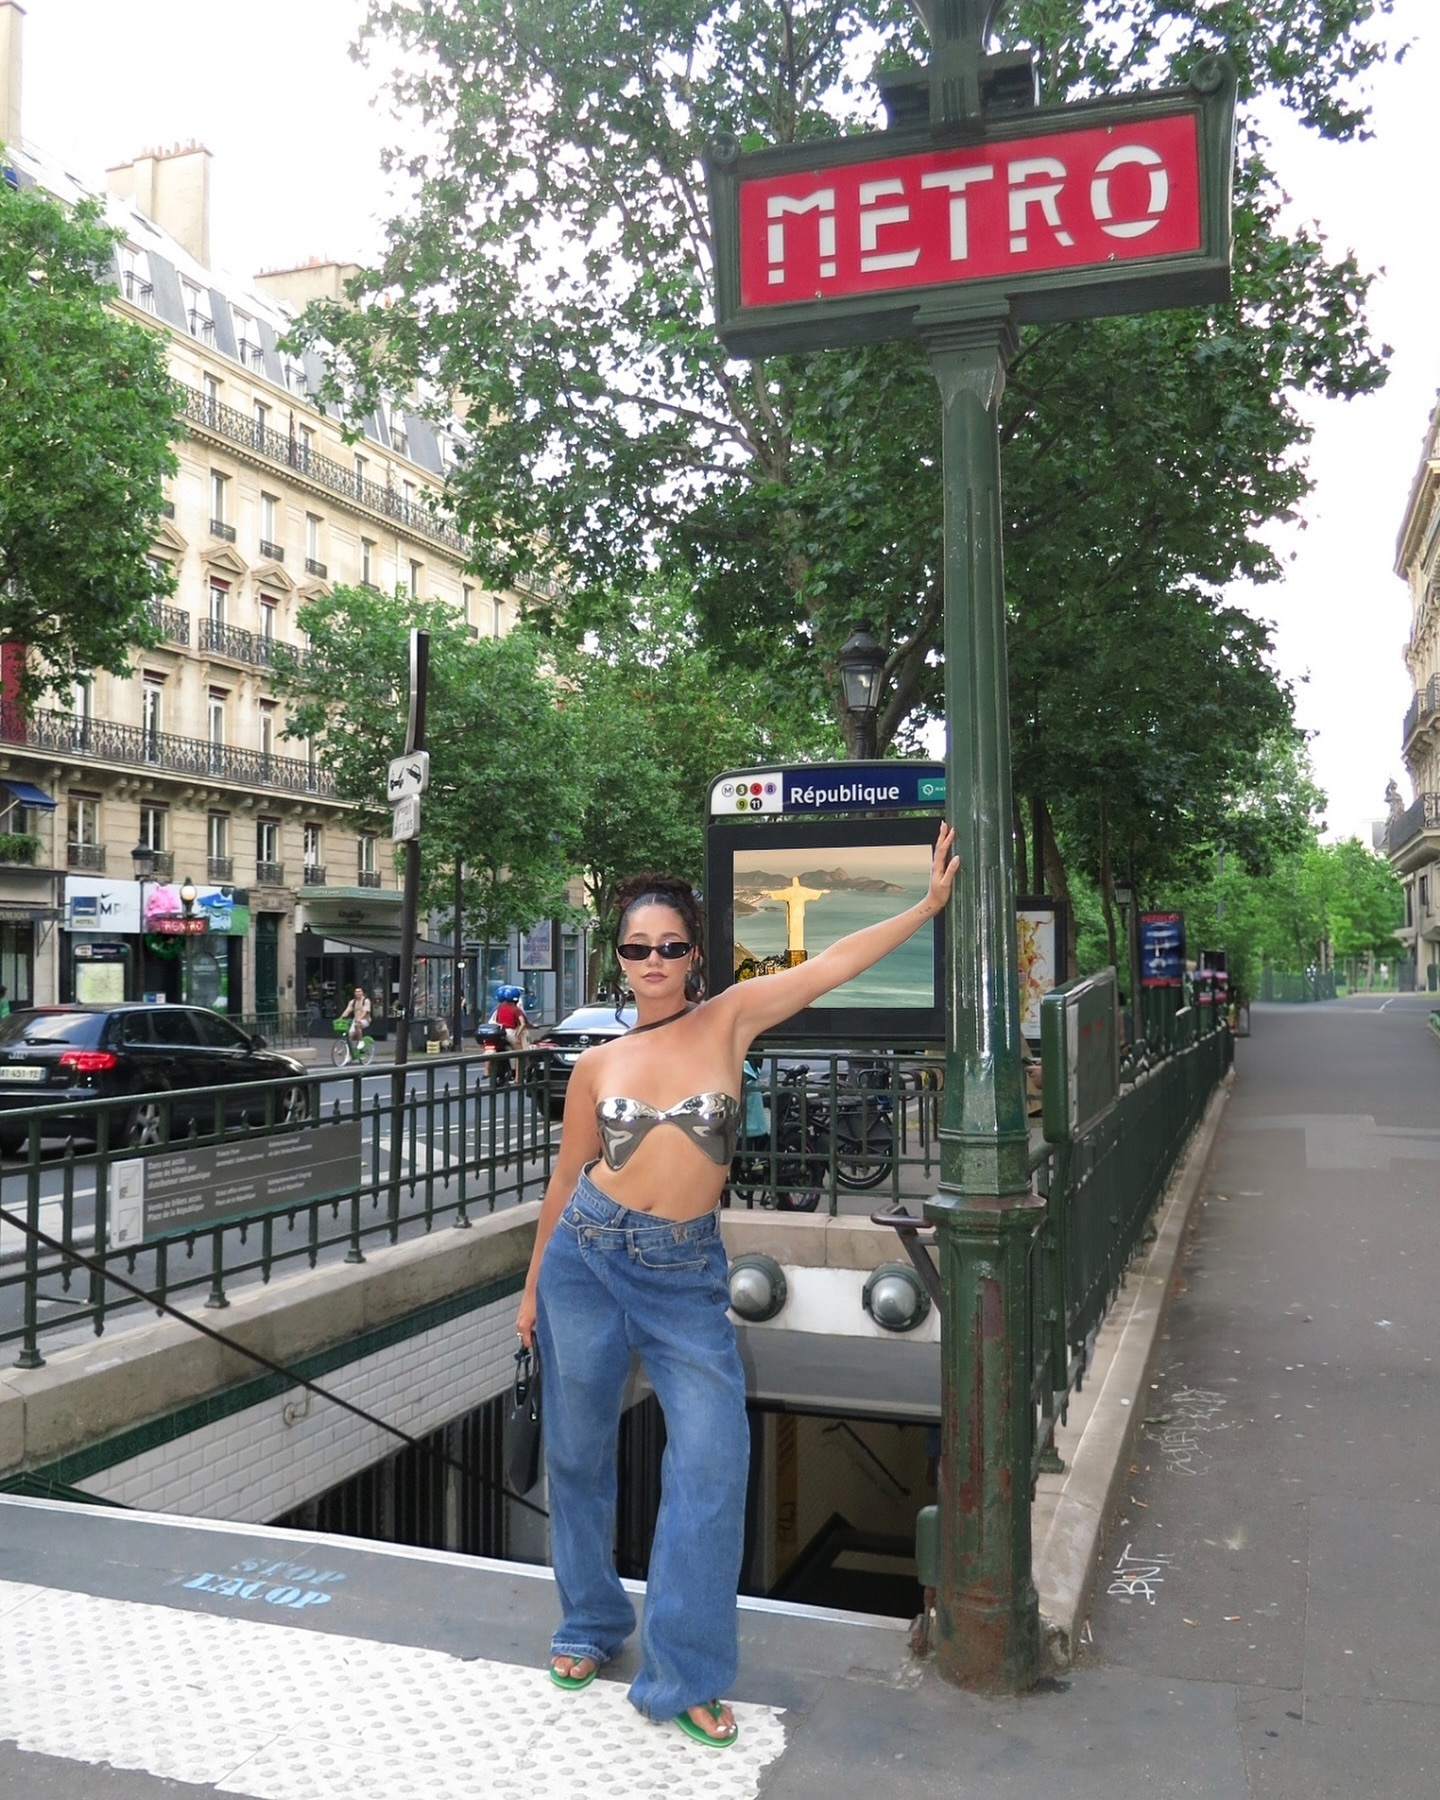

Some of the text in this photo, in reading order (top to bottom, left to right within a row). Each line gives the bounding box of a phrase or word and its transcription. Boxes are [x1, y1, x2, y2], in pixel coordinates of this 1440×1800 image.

[767, 144, 1169, 285] METRO
[790, 784, 900, 807] République
[231, 1558, 347, 1585] STOP
